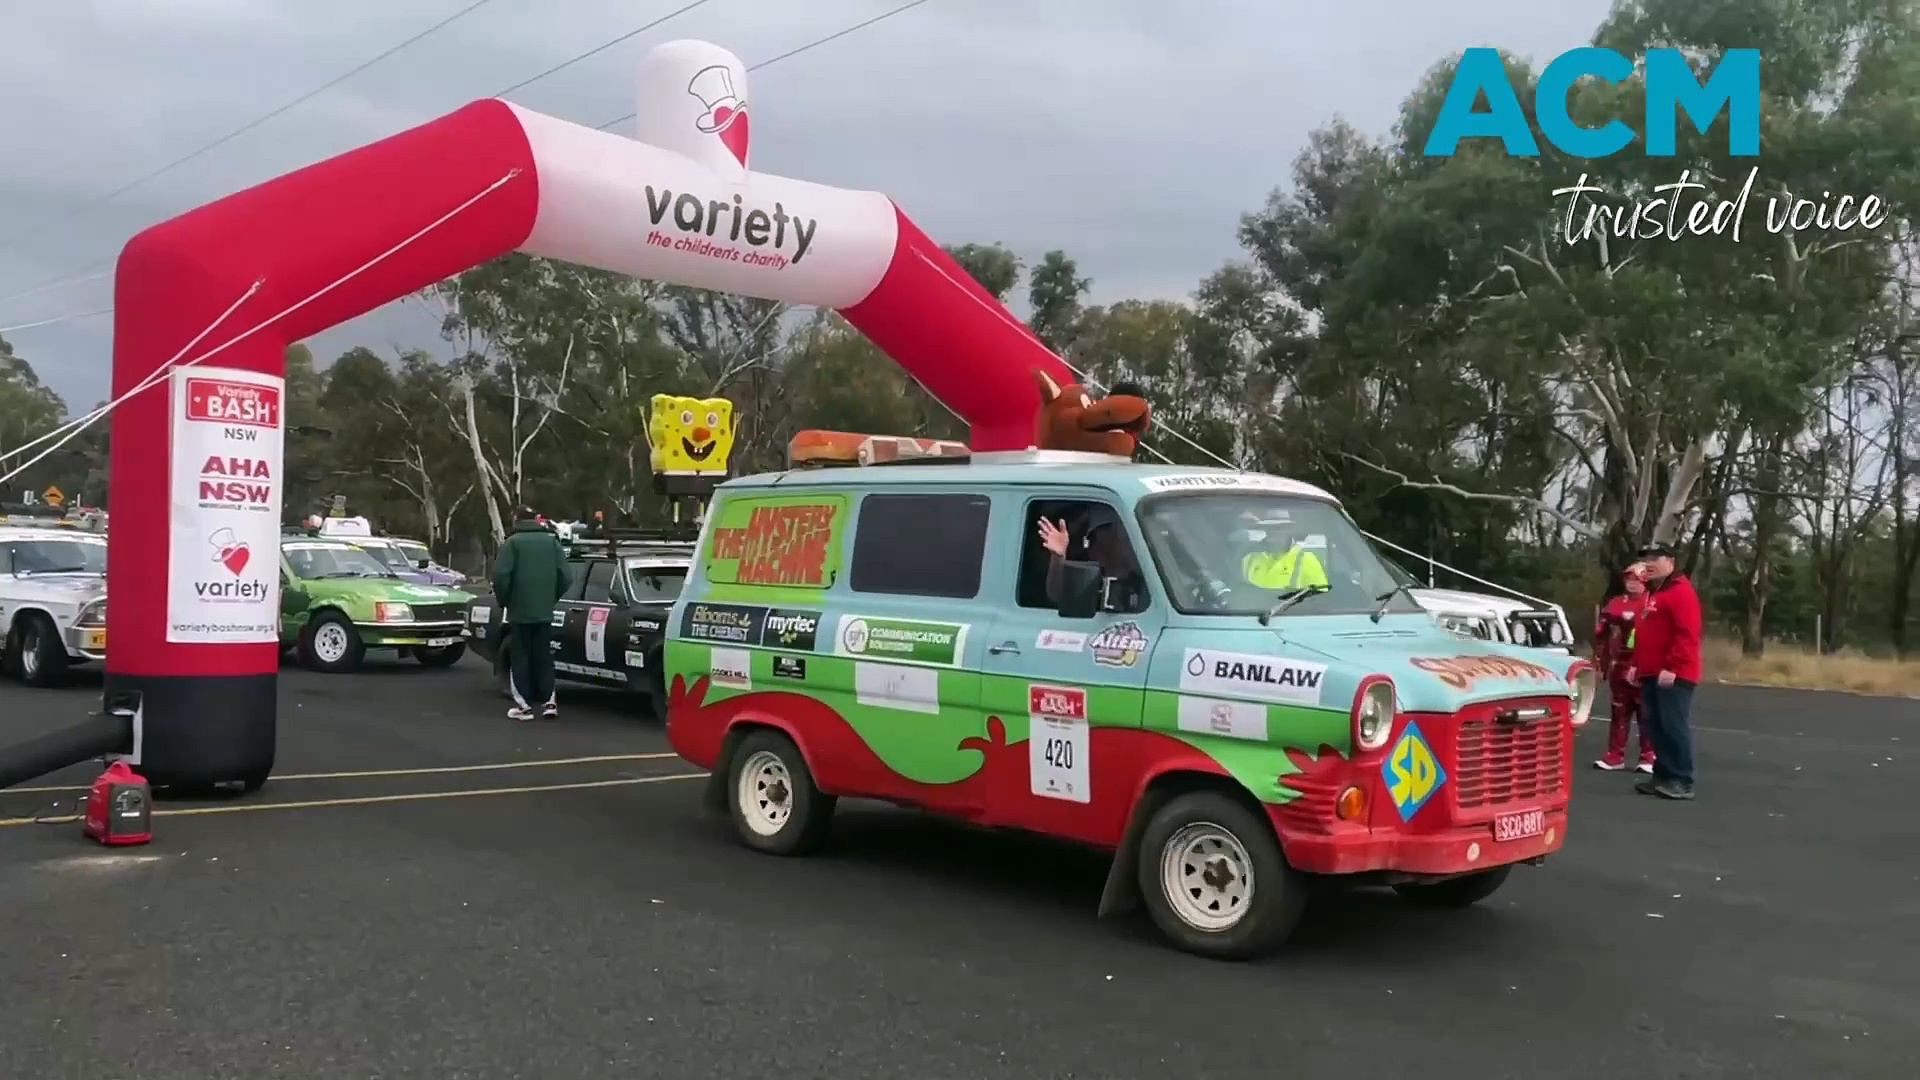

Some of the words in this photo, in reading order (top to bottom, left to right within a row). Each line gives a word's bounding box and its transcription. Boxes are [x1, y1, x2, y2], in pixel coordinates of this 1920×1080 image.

[645, 184, 816, 264] variety
[647, 231, 672, 249] the
[674, 237, 739, 262] children's
[742, 251, 788, 270] charity
[207, 396, 270, 422] BASH
[224, 427, 258, 441] NSW
[201, 456, 270, 478] AHA
[199, 481, 270, 503] NSW
[194, 579, 269, 602] variety
[767, 614, 815, 635] myrtec
[1214, 660, 1322, 688] BANLAW
[1045, 738, 1073, 769] 420
[1391, 734, 1437, 807] SD
